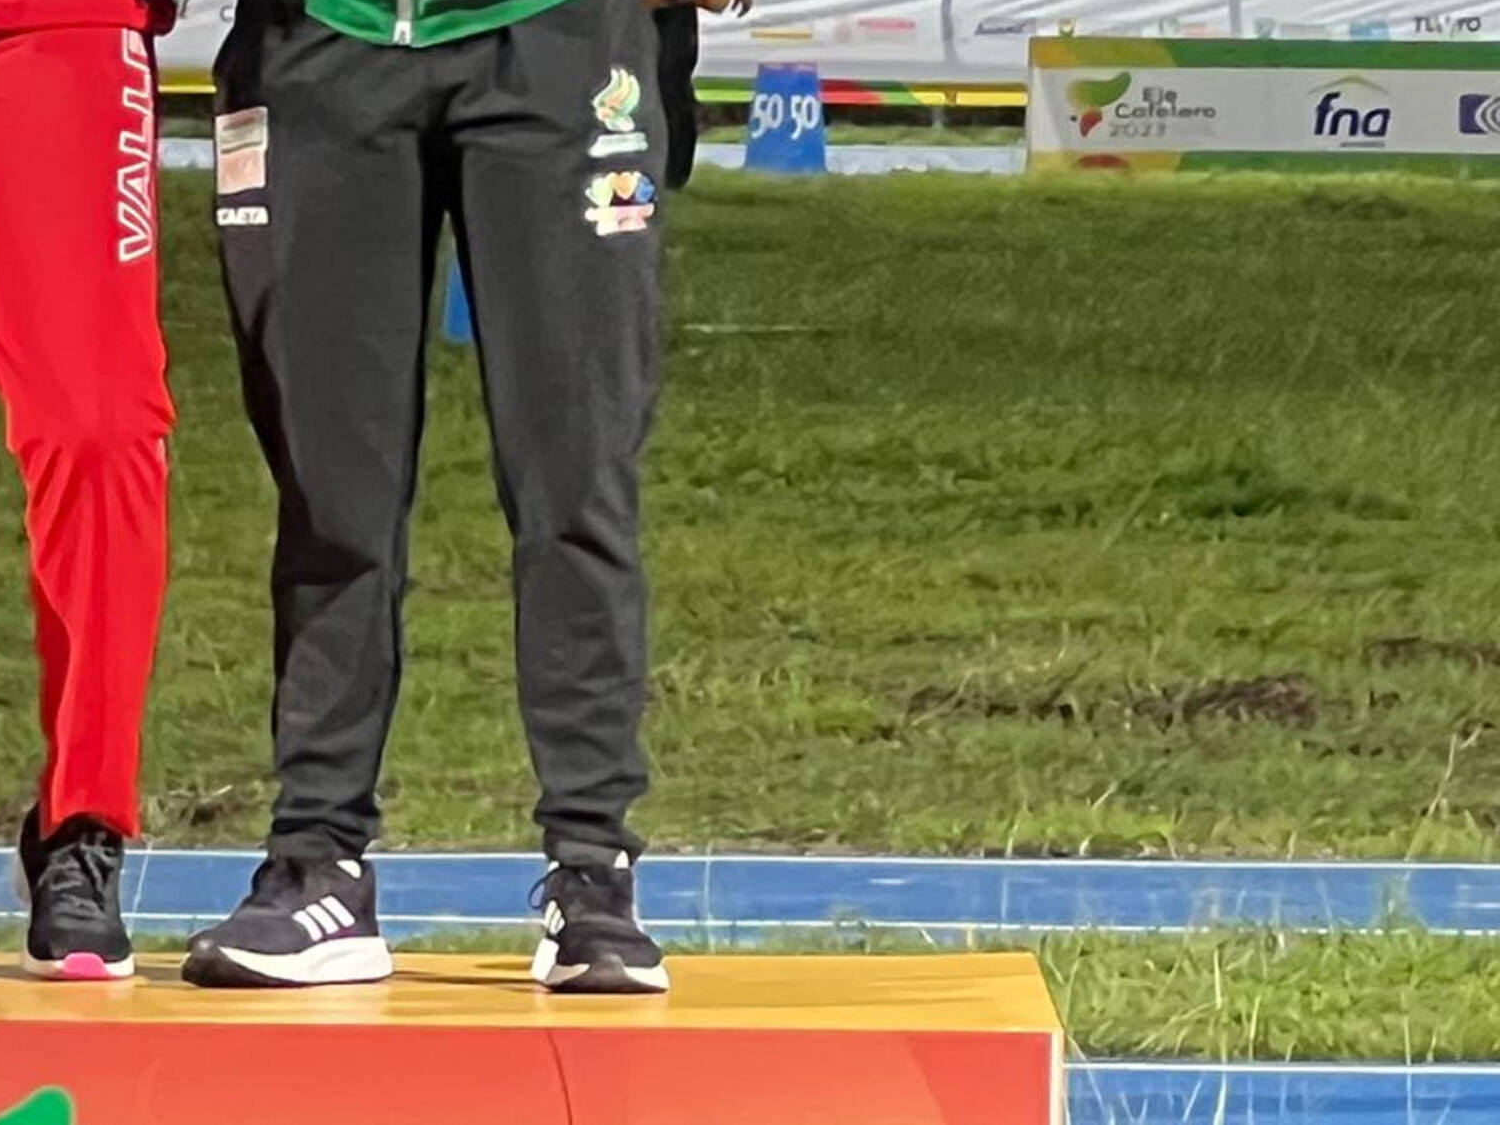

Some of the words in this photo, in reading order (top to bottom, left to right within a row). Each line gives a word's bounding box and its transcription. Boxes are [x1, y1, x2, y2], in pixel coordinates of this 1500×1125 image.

[750, 93, 784, 138] 50
[790, 94, 821, 140] 50
[1314, 91, 1391, 137] fna
